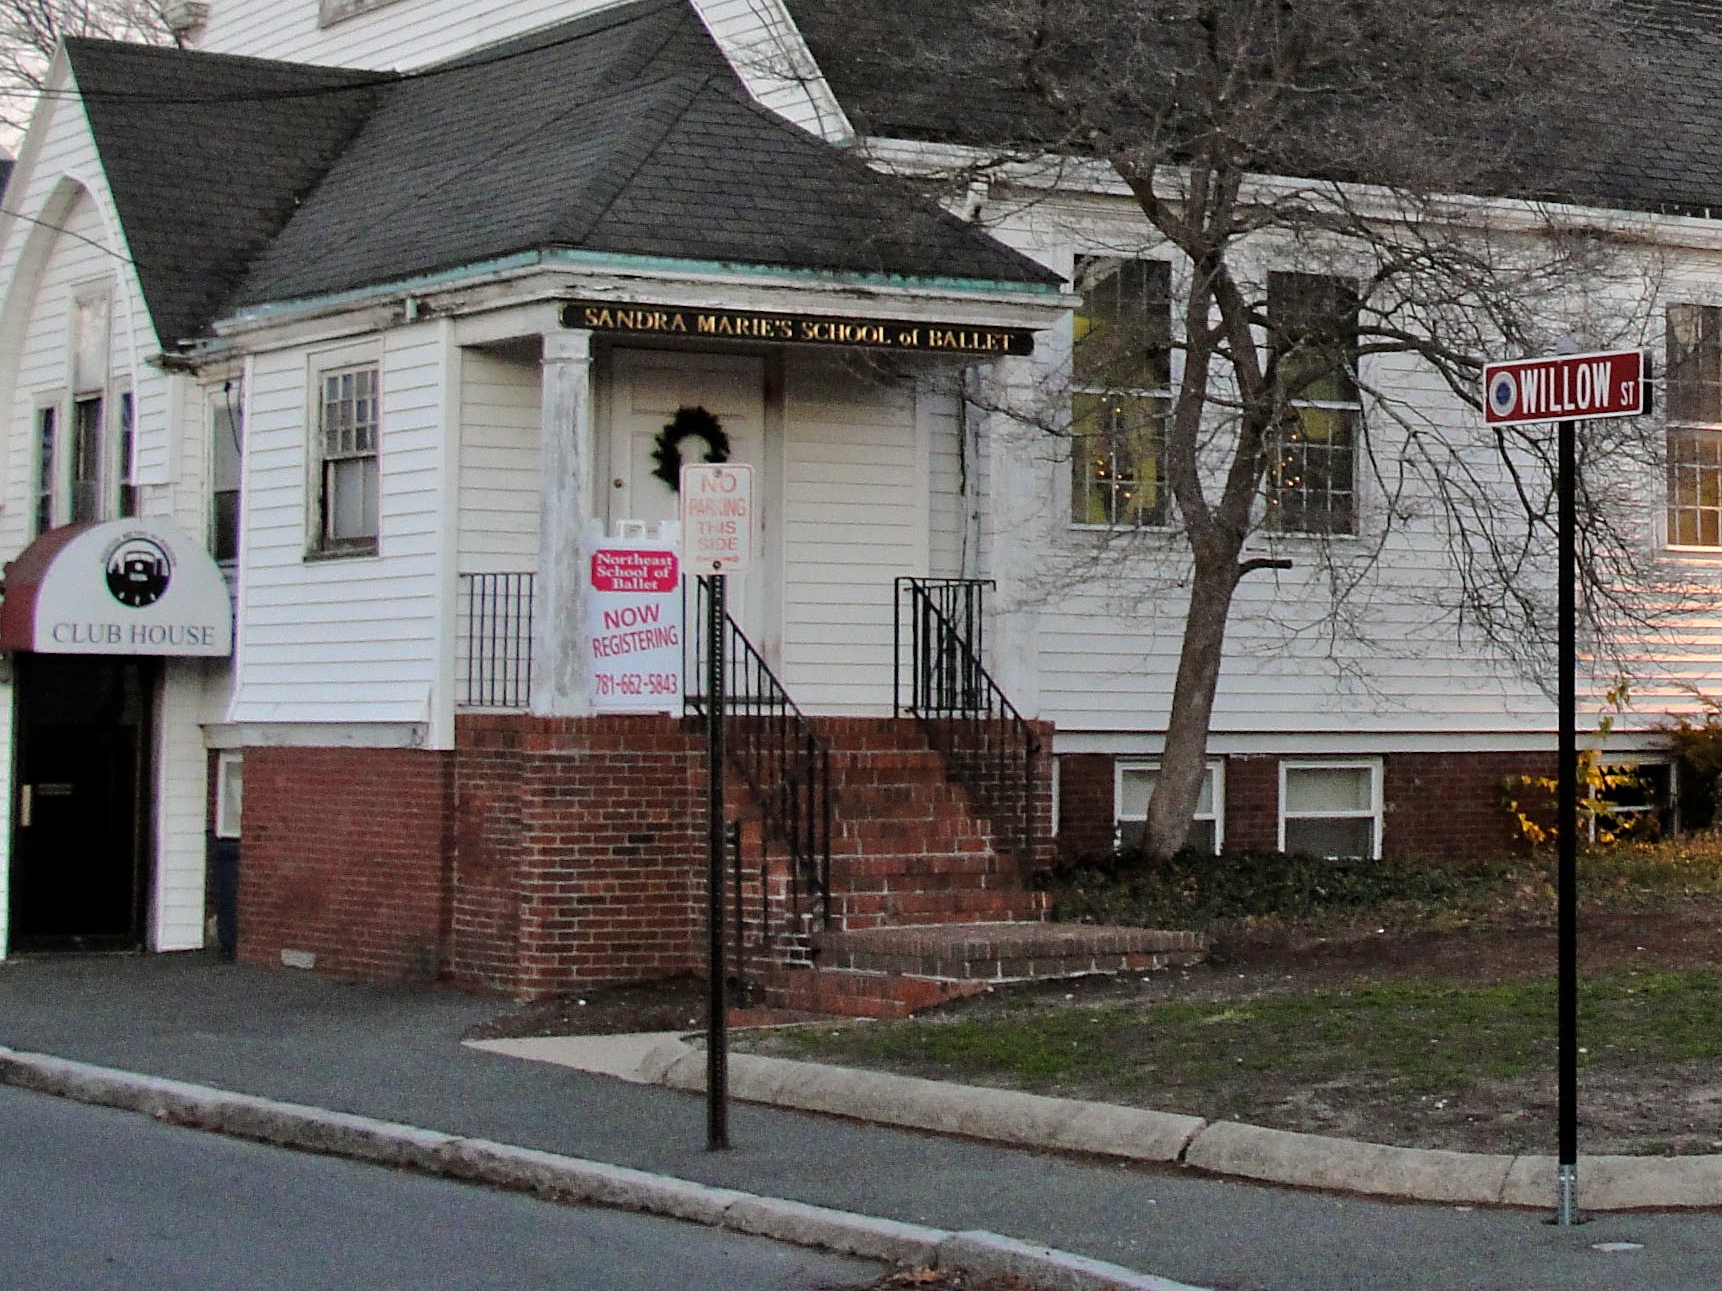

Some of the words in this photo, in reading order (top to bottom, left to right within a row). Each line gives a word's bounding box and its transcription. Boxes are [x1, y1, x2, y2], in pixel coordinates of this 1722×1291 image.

[584, 307, 687, 333] SANDRA
[697, 314, 793, 338] MARIE'S
[802, 321, 892, 344] SCHOOL
[899, 328, 920, 346] of
[928, 329, 1014, 351] BALLET
[1520, 361, 1612, 414] WILLOW
[1620, 381, 1635, 406] ST
[701, 473, 737, 493] NO
[689, 497, 746, 517] PARKING
[698, 521, 737, 535] THIS
[698, 537, 738, 550] SIDE
[597, 552, 673, 567] Northeast
[596, 566, 648, 578] School
[653, 565, 672, 578] of
[612, 578, 658, 590] Ballet
[603, 603, 660, 630] NOW
[53, 622, 121, 644] CLUB
[130, 624, 216, 646] HOUSE
[592, 625, 679, 659] REGISTERING
[594, 673, 678, 695] 781-662-5843
